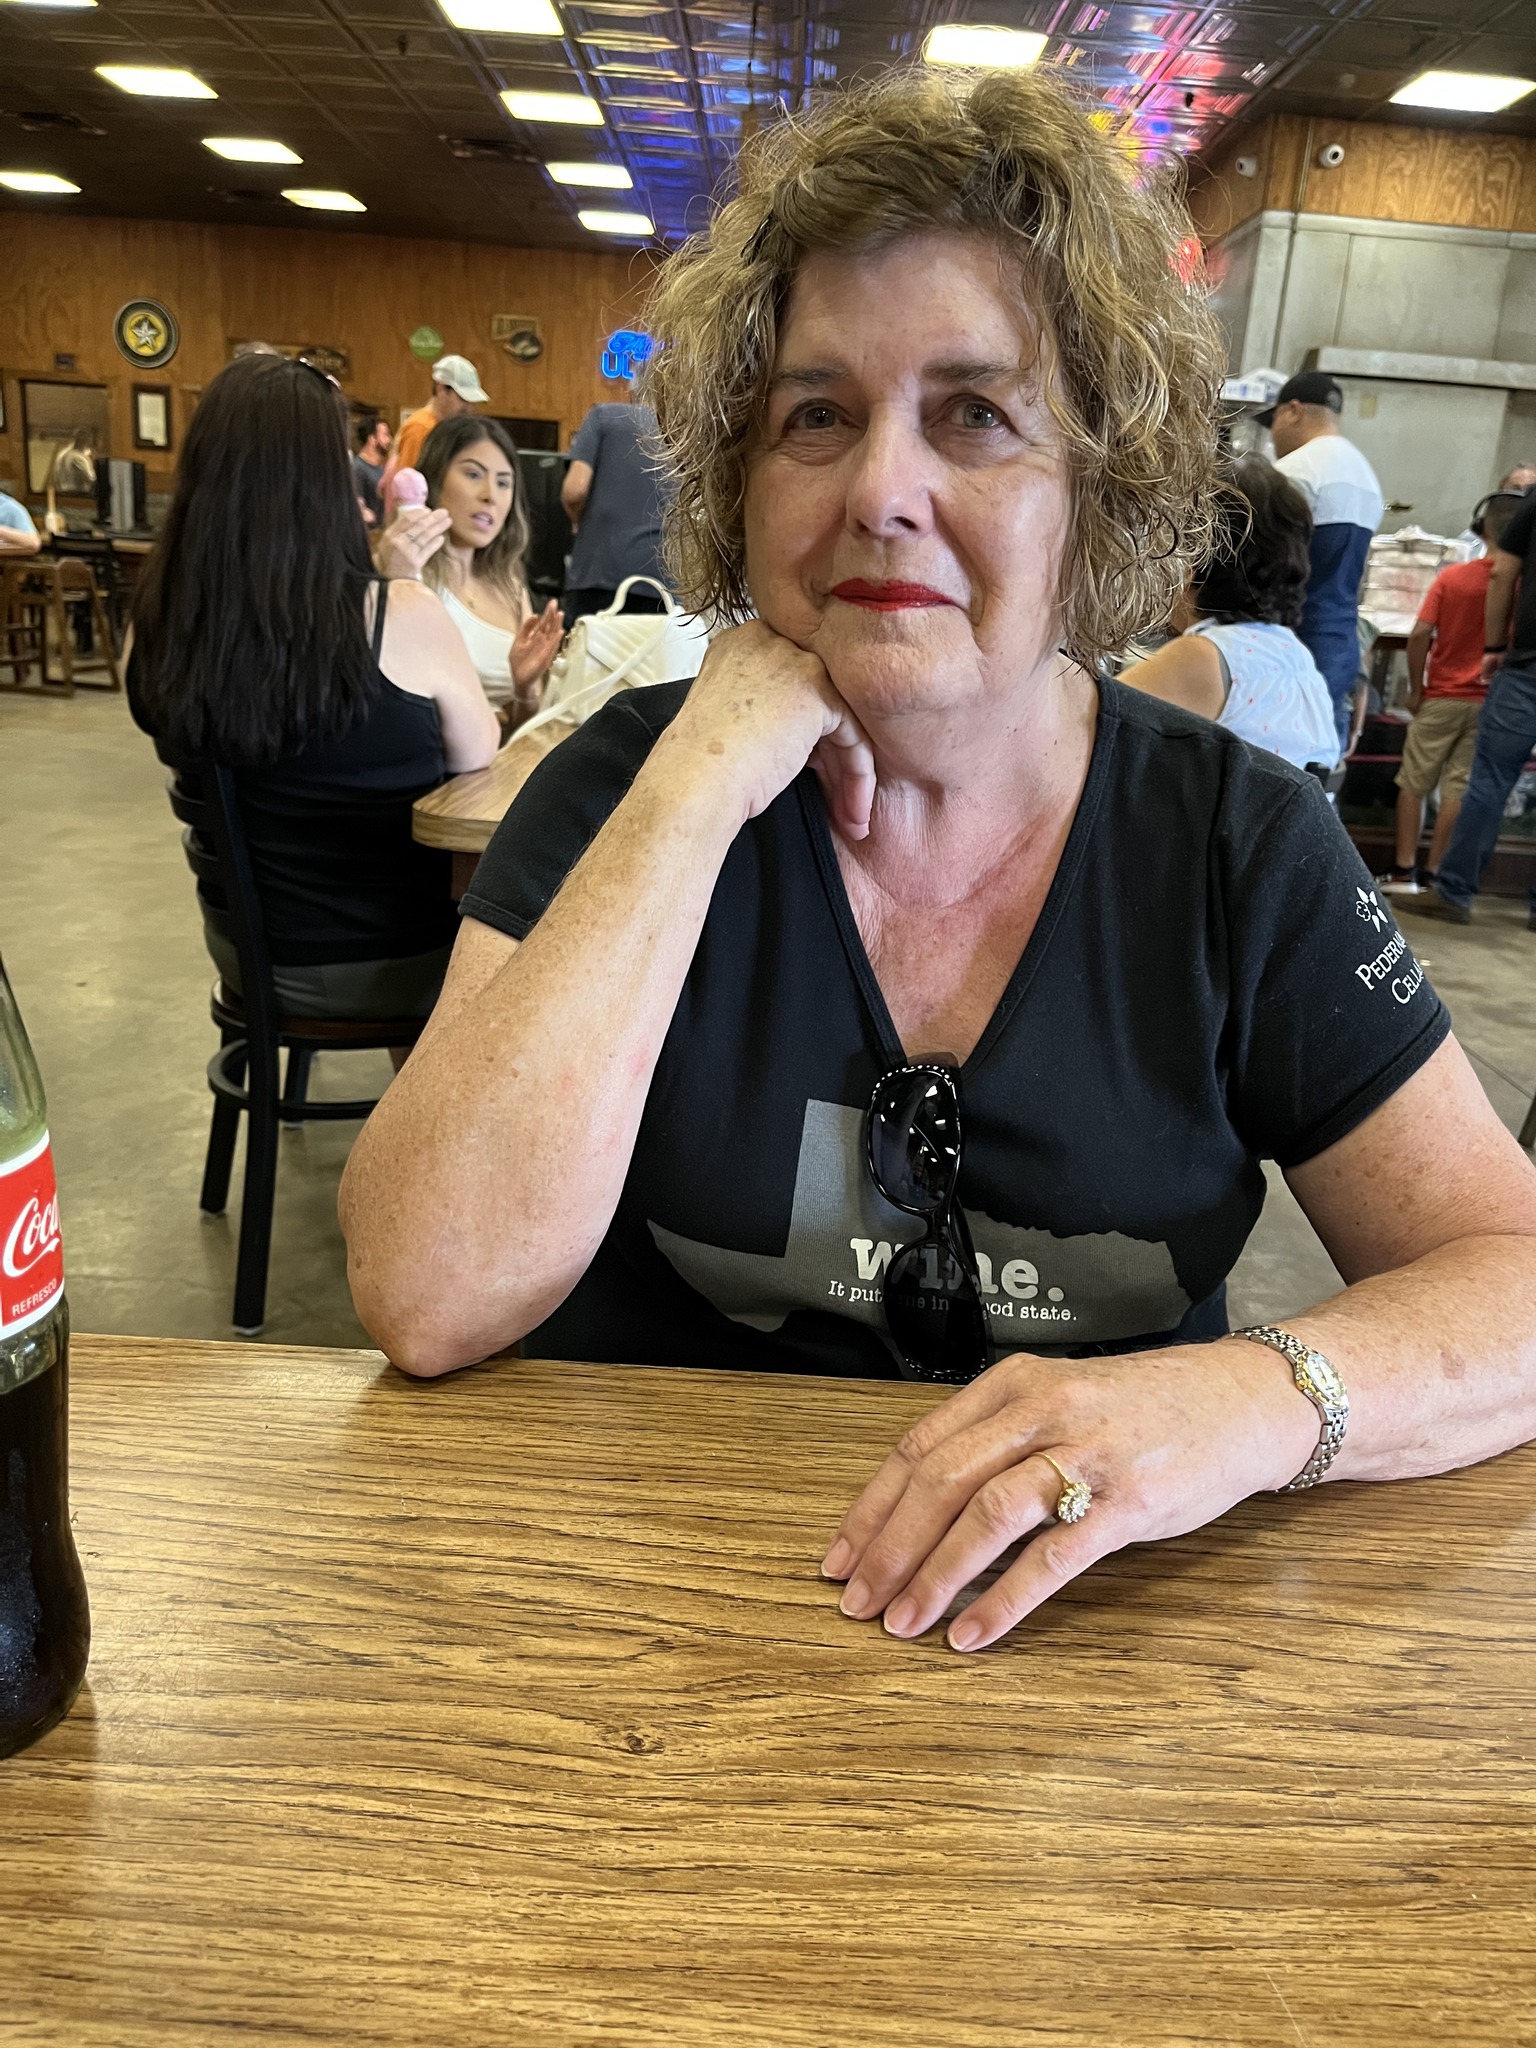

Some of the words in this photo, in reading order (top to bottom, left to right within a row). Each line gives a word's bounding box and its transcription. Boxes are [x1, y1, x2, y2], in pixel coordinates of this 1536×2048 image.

[602, 351, 634, 380] UL
[12, 1278, 57, 1316] REFRESCO
[828, 1281, 845, 1297] It
[849, 1287, 884, 1303] put
[1020, 1304, 1077, 1321] state.
